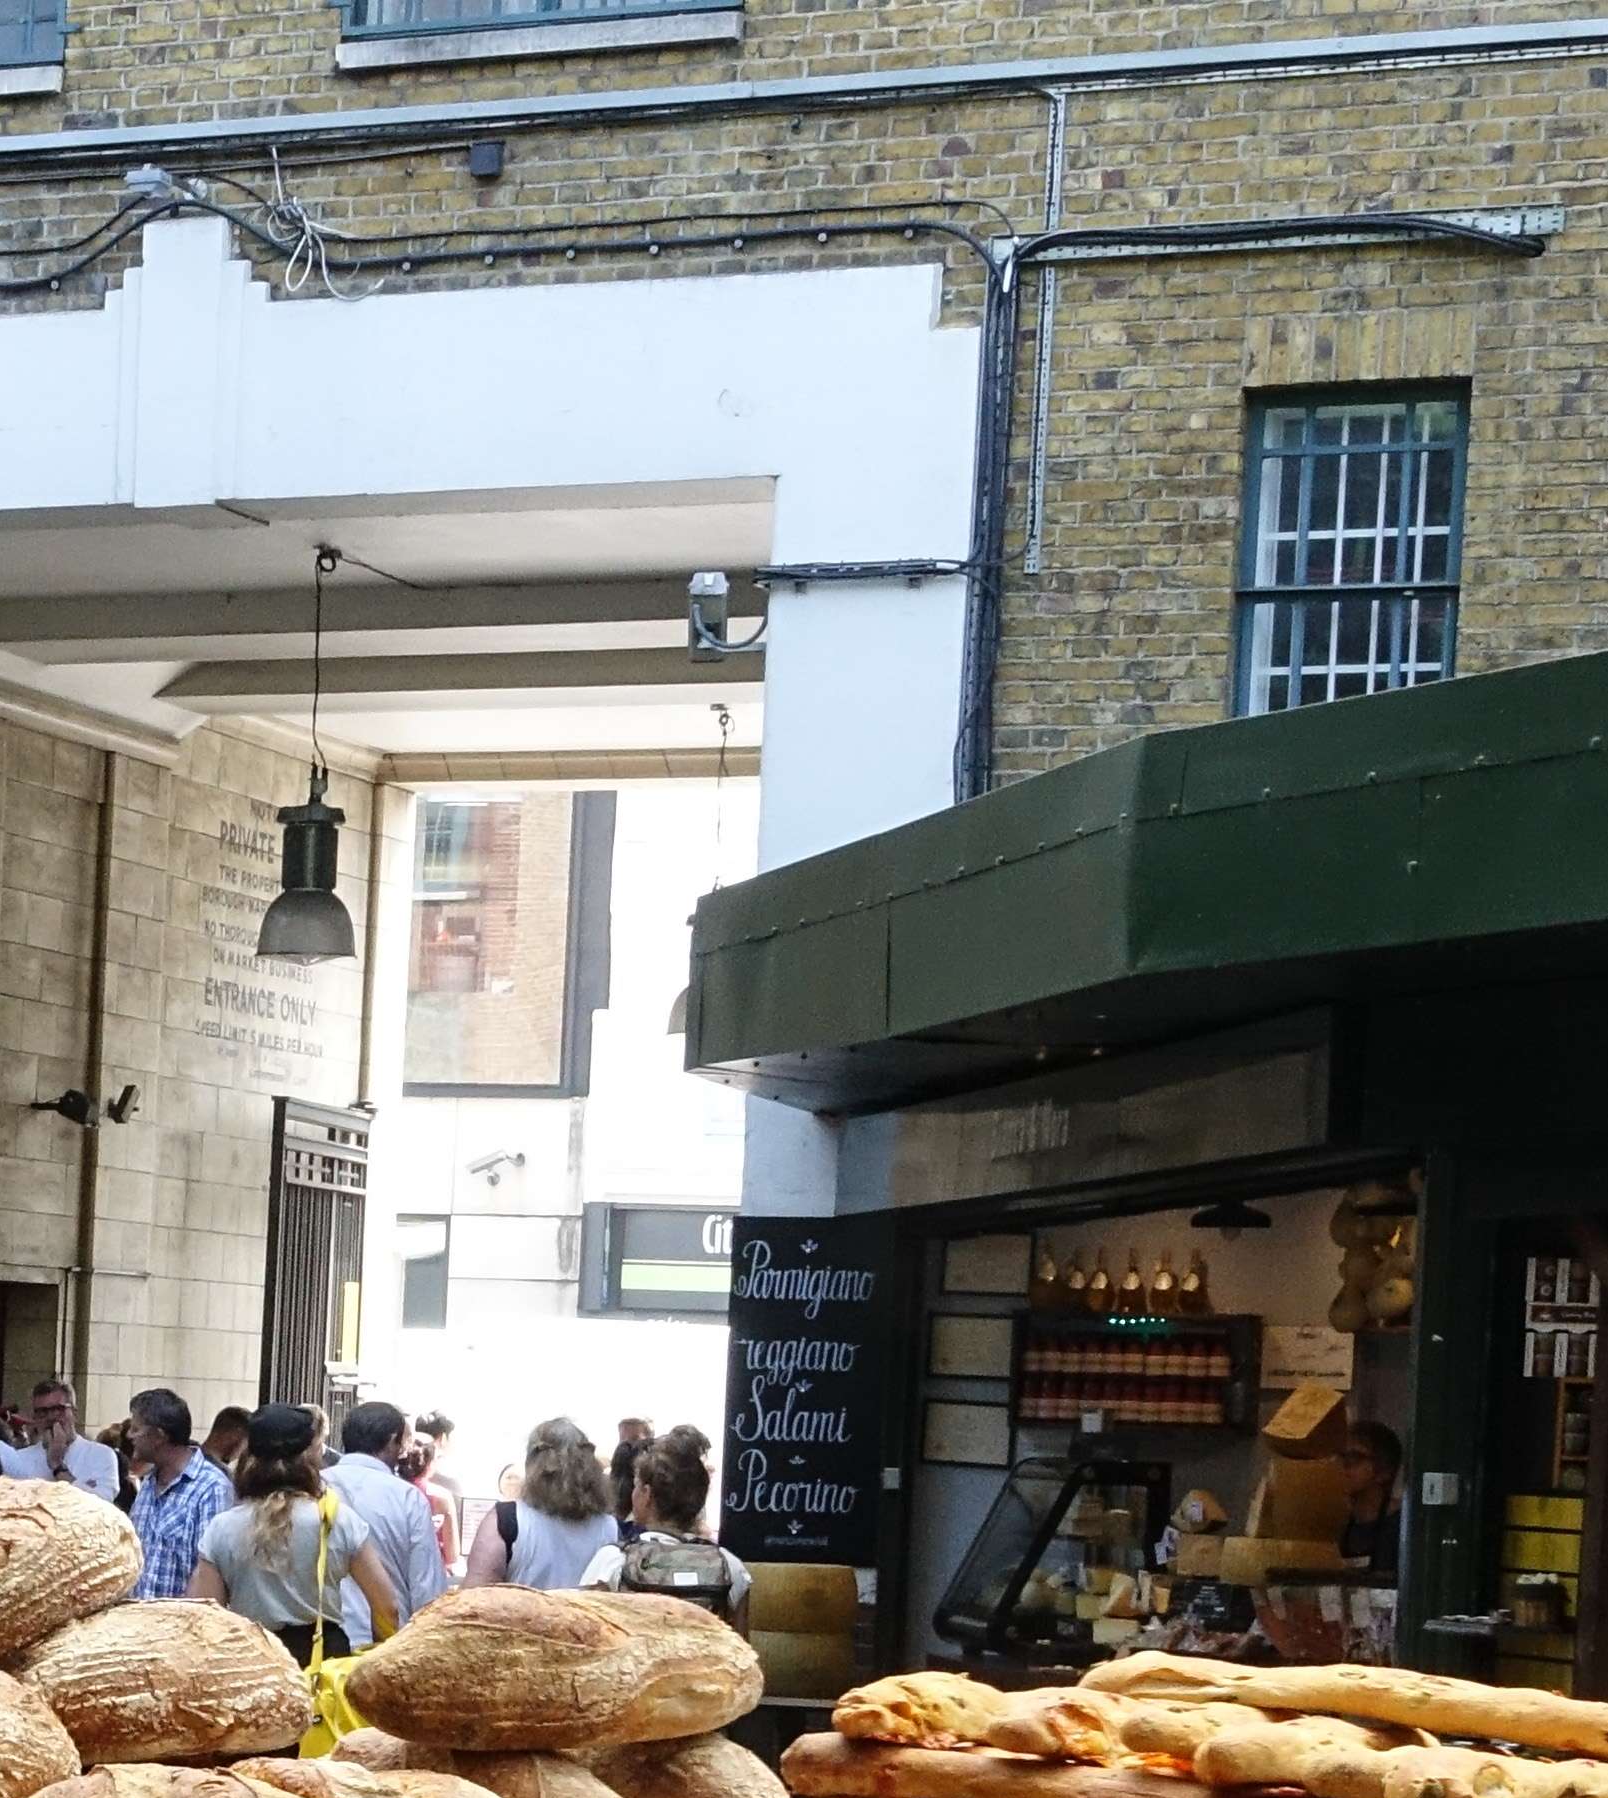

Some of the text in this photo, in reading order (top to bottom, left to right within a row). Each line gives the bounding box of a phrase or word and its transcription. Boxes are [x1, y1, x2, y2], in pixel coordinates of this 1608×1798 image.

[219, 820, 276, 864] PRIVATE
[218, 863, 282, 895] THE PROPERT
[228, 949, 266, 974] MARKET
[204, 976, 317, 1027] ENTRANCE ONLY
[734, 1240, 874, 1320] Parmigiano
[735, 1337, 861, 1386] reggiano
[730, 1375, 852, 1442] Salami
[726, 1449, 859, 1513] Pecorino
